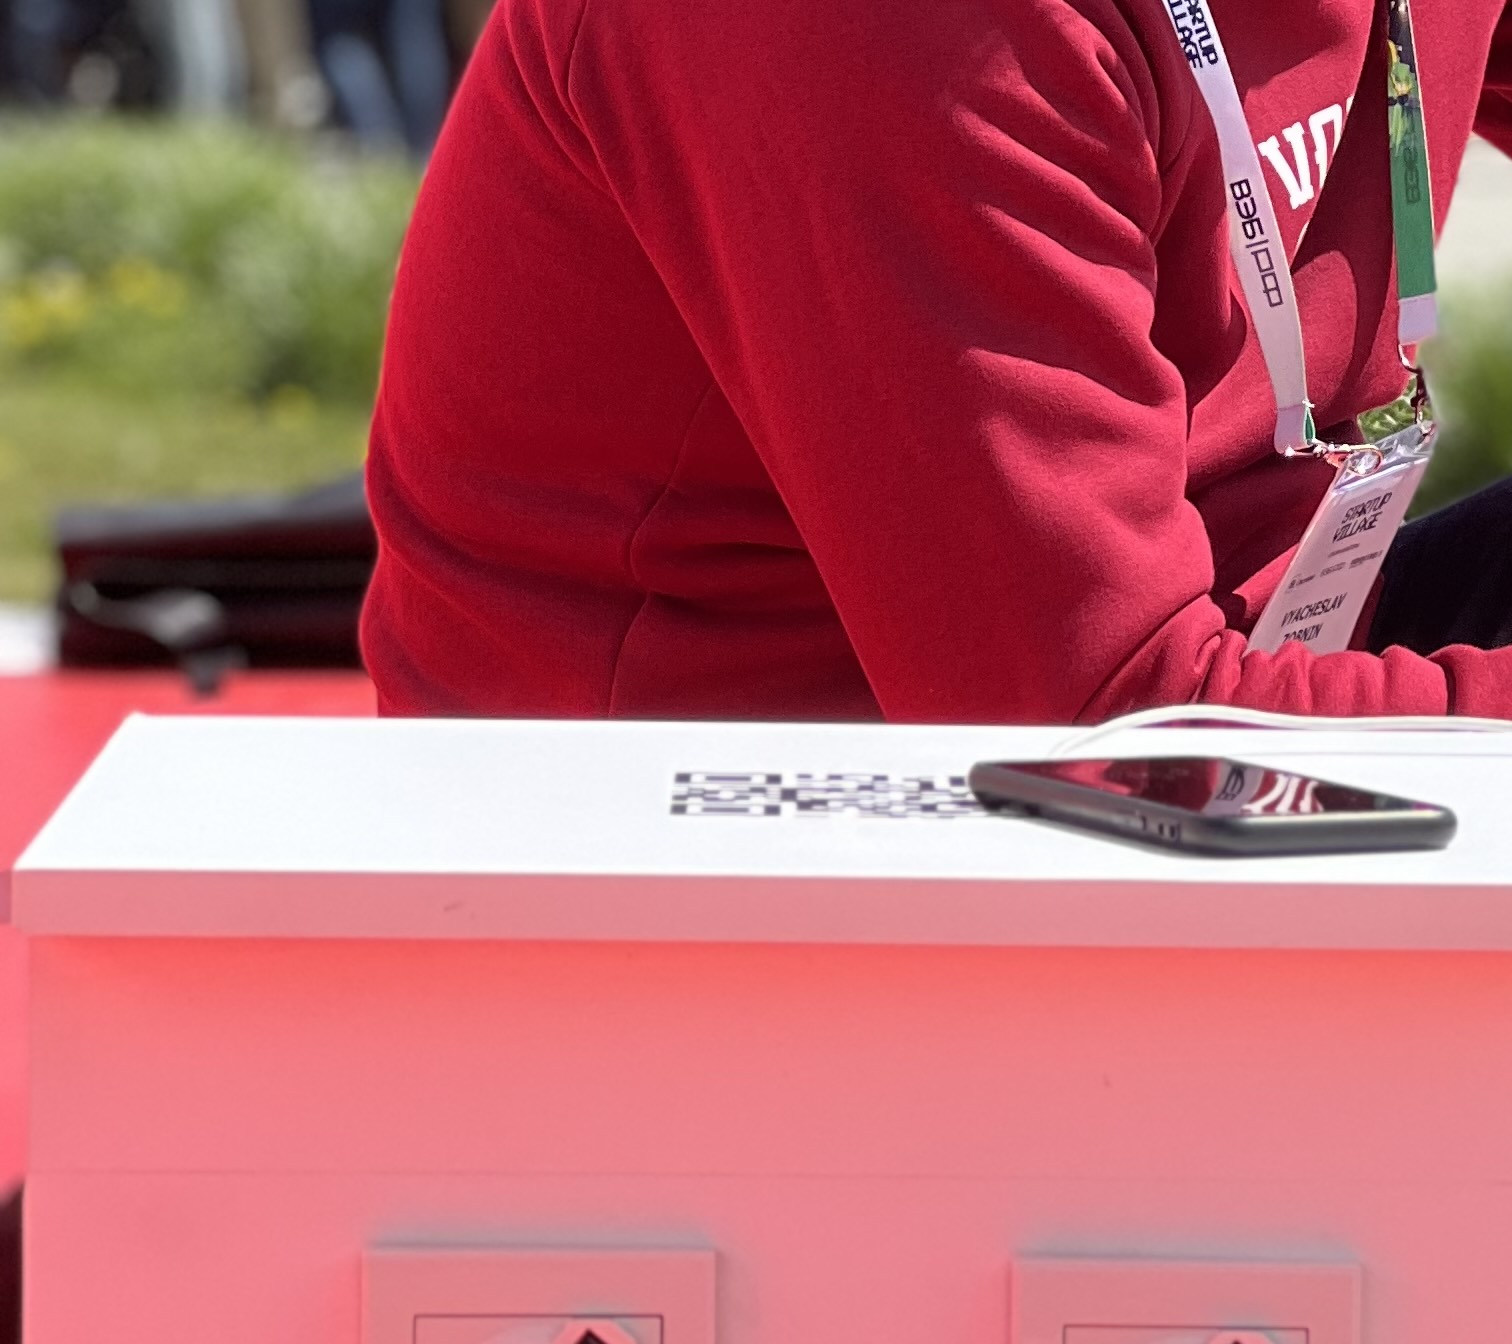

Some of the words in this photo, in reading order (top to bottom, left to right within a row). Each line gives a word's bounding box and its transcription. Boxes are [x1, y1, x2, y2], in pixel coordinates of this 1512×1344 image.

[1341, 492, 1393, 524] STARTUP
[1332, 511, 1383, 543] VILLAGE
[1281, 592, 1348, 627] VYACHESLAV
